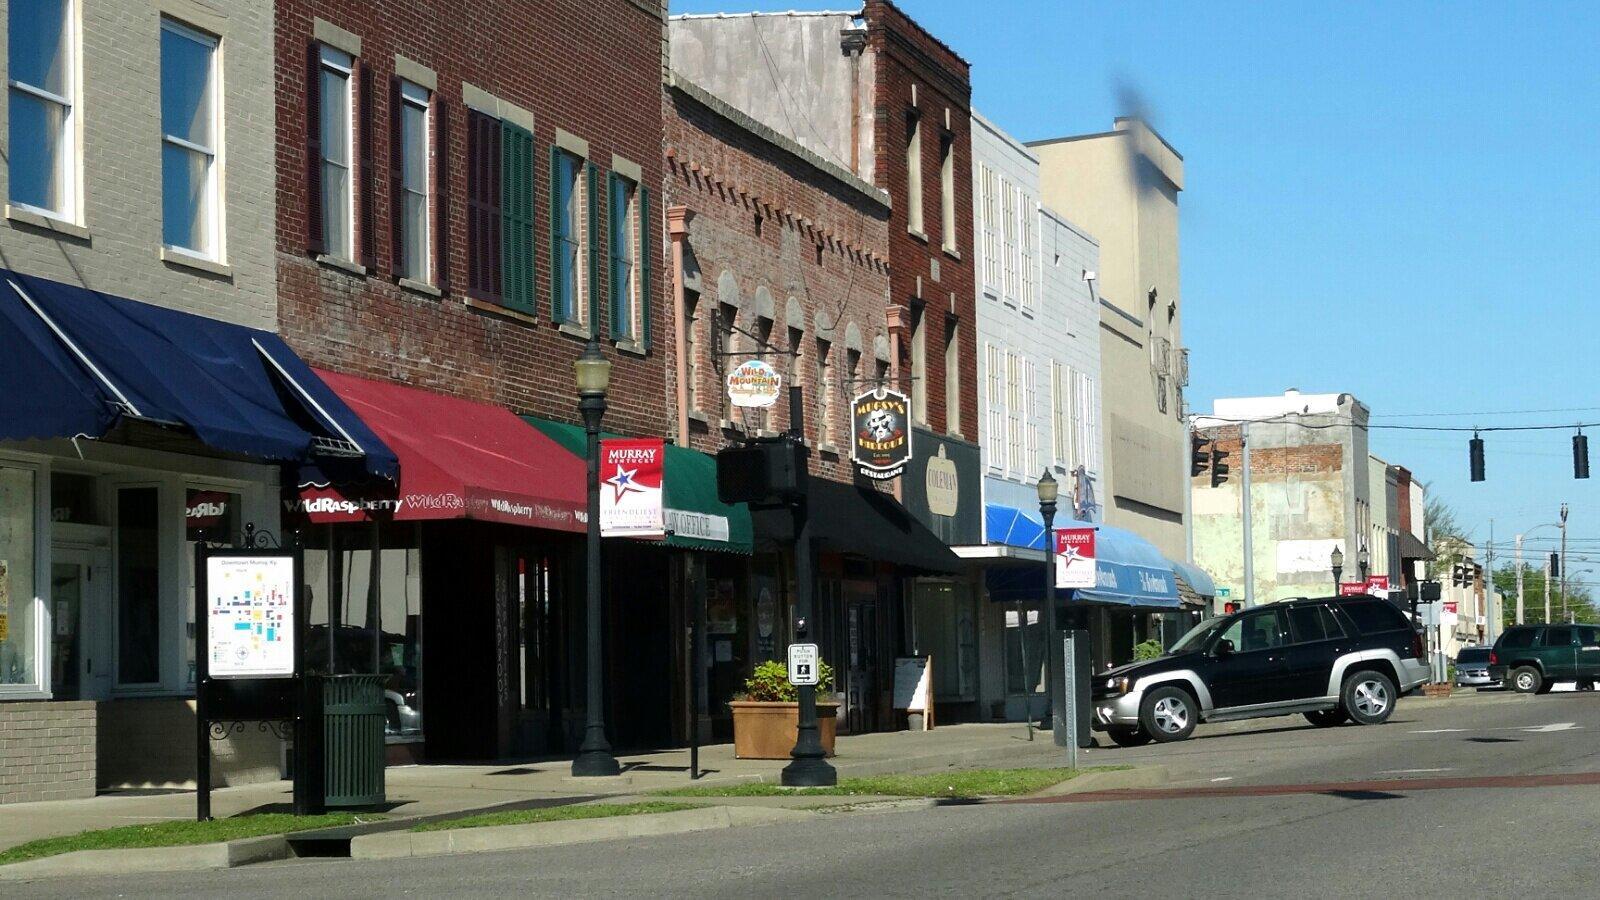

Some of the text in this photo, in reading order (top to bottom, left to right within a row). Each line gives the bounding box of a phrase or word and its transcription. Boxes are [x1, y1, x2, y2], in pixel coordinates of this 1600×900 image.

[857, 401, 905, 416] MUGSY'S
[859, 435, 904, 450] HIDEOUT
[608, 449, 656, 459] MURRAY
[860, 467, 903, 480] RESTAURANT
[680, 513, 711, 537] OFFICE
